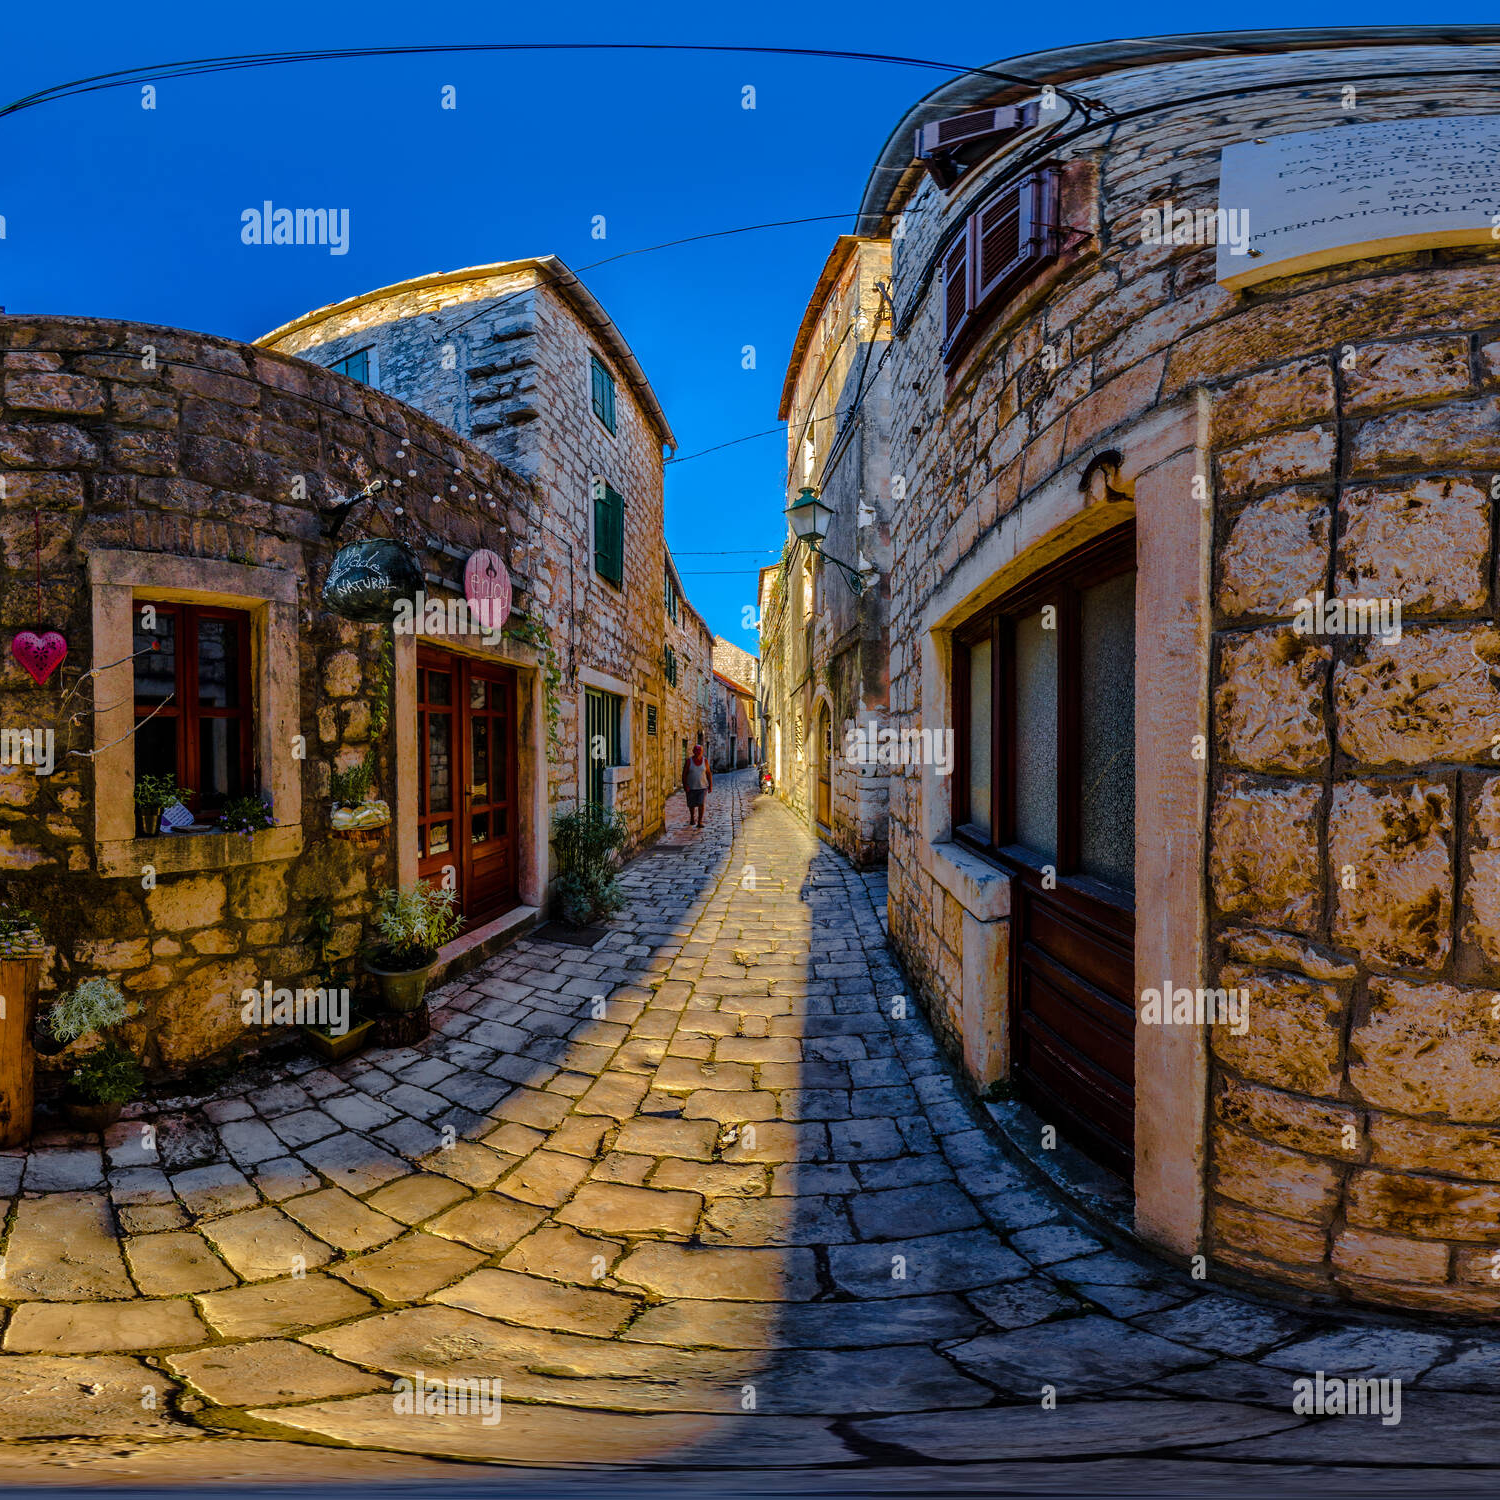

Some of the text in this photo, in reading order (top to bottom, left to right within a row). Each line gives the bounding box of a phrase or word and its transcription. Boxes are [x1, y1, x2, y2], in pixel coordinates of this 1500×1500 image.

[1248, 199, 1449, 243] INTERNATIONAL
[1401, 204, 1477, 216] HALL
[336, 575, 397, 597] NATURAL
